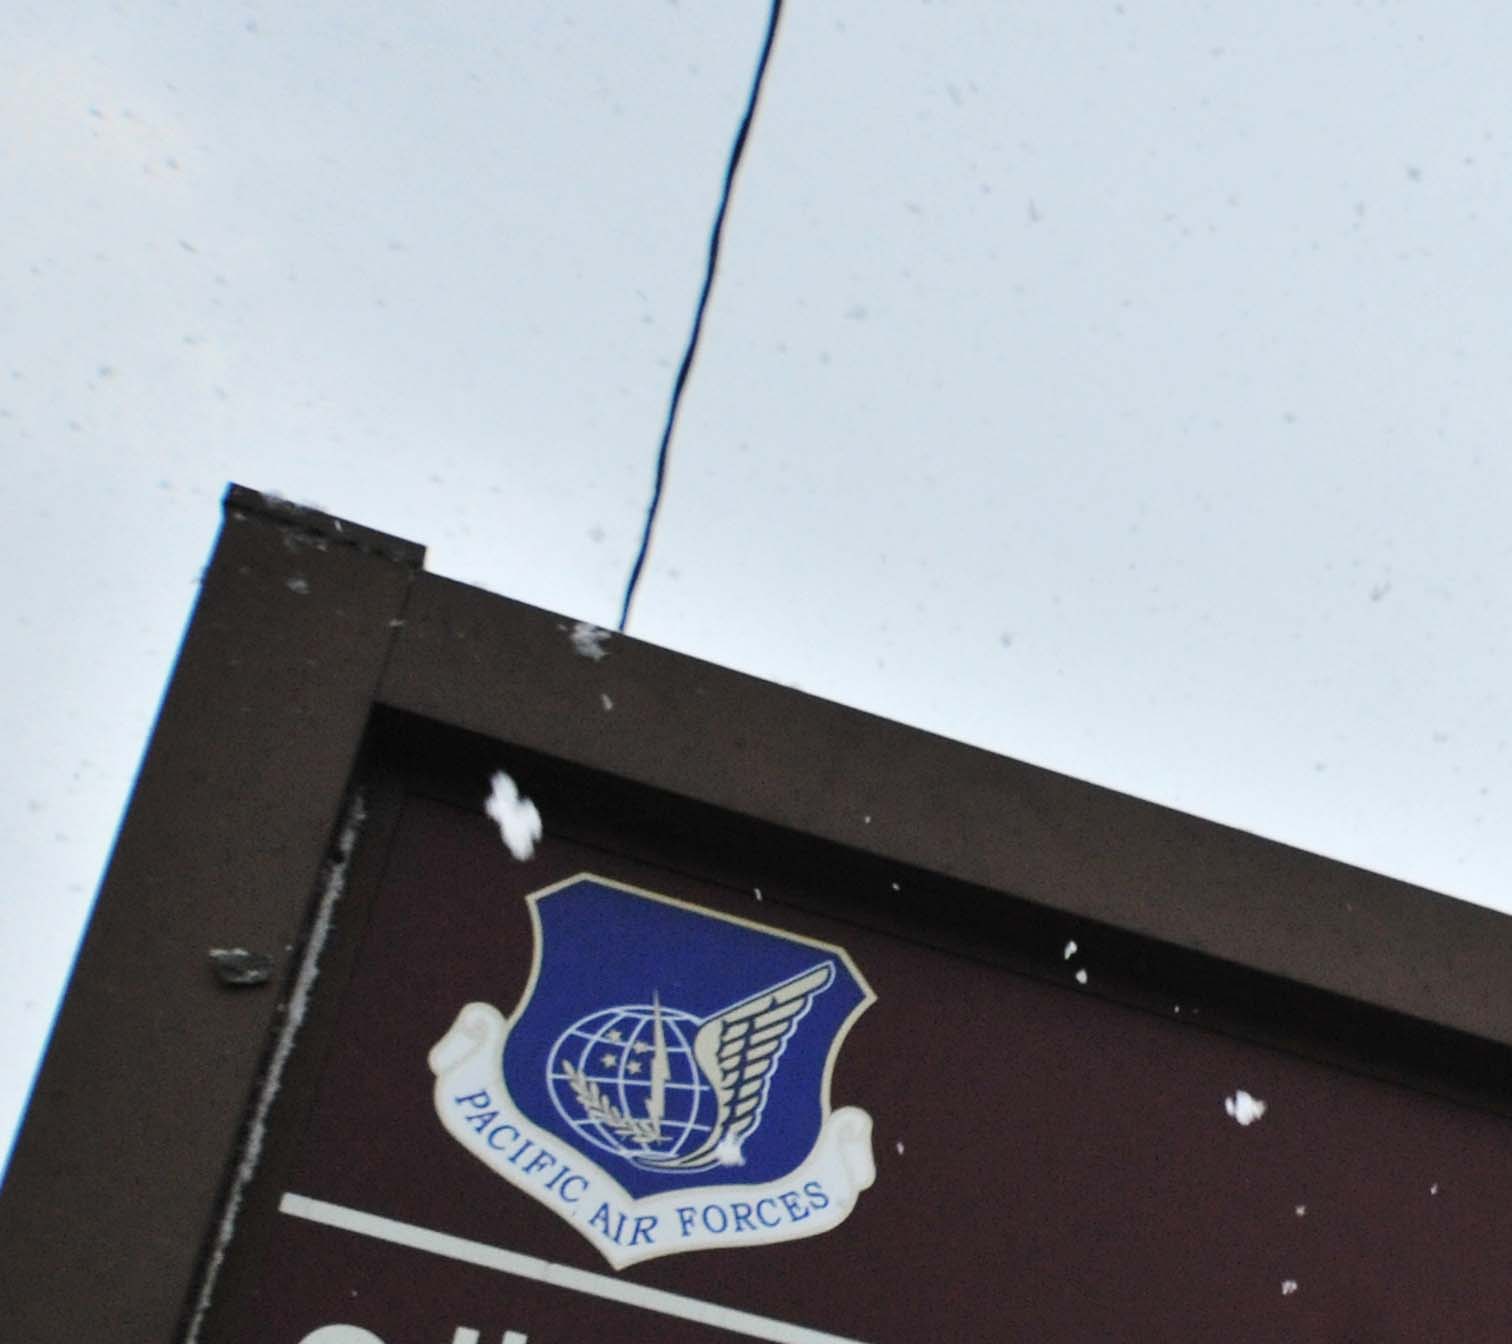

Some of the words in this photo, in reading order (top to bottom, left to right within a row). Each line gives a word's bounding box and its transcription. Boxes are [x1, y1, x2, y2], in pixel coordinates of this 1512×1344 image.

[454, 1089, 589, 1204] PACIFIC
[589, 1202, 659, 1246] AIR
[677, 1180, 831, 1238] FORCES
